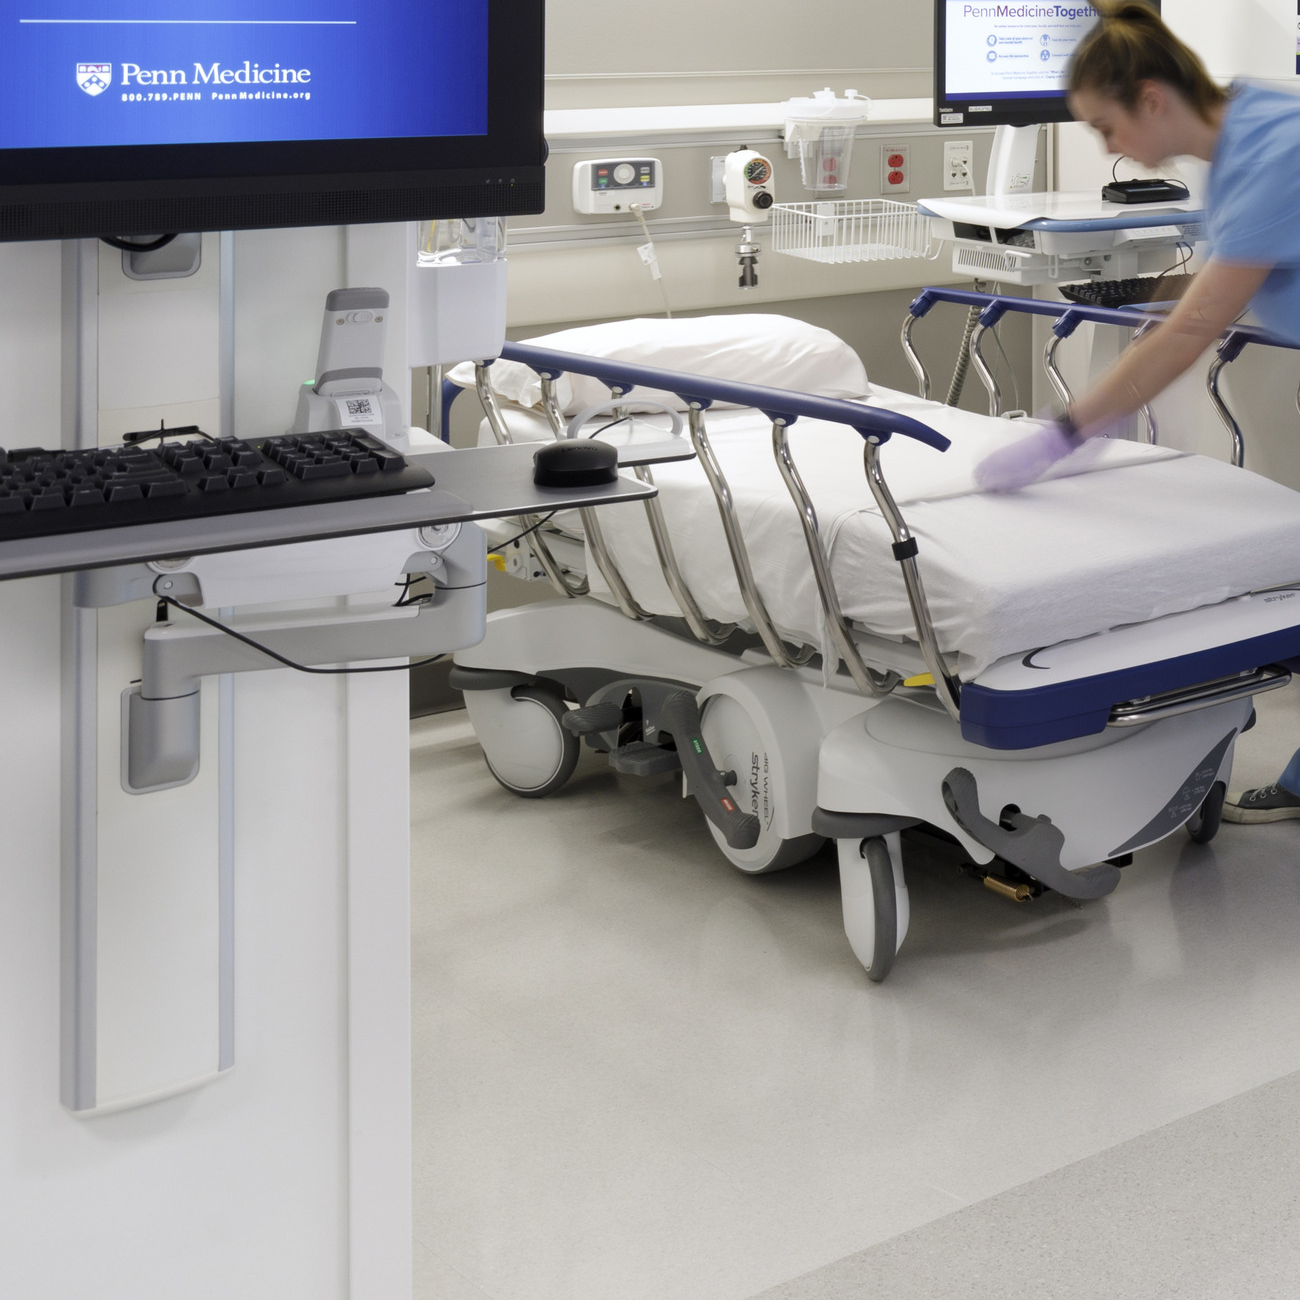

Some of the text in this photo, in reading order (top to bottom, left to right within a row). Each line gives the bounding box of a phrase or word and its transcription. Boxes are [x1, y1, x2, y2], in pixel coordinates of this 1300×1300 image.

[963, 5, 1100, 20] PennMedicineTogeth
[121, 61, 312, 85] Penn Medicine
[121, 91, 311, 102] 800.789.PENN PennMedicine.org
[750, 752, 761, 819] stryker
